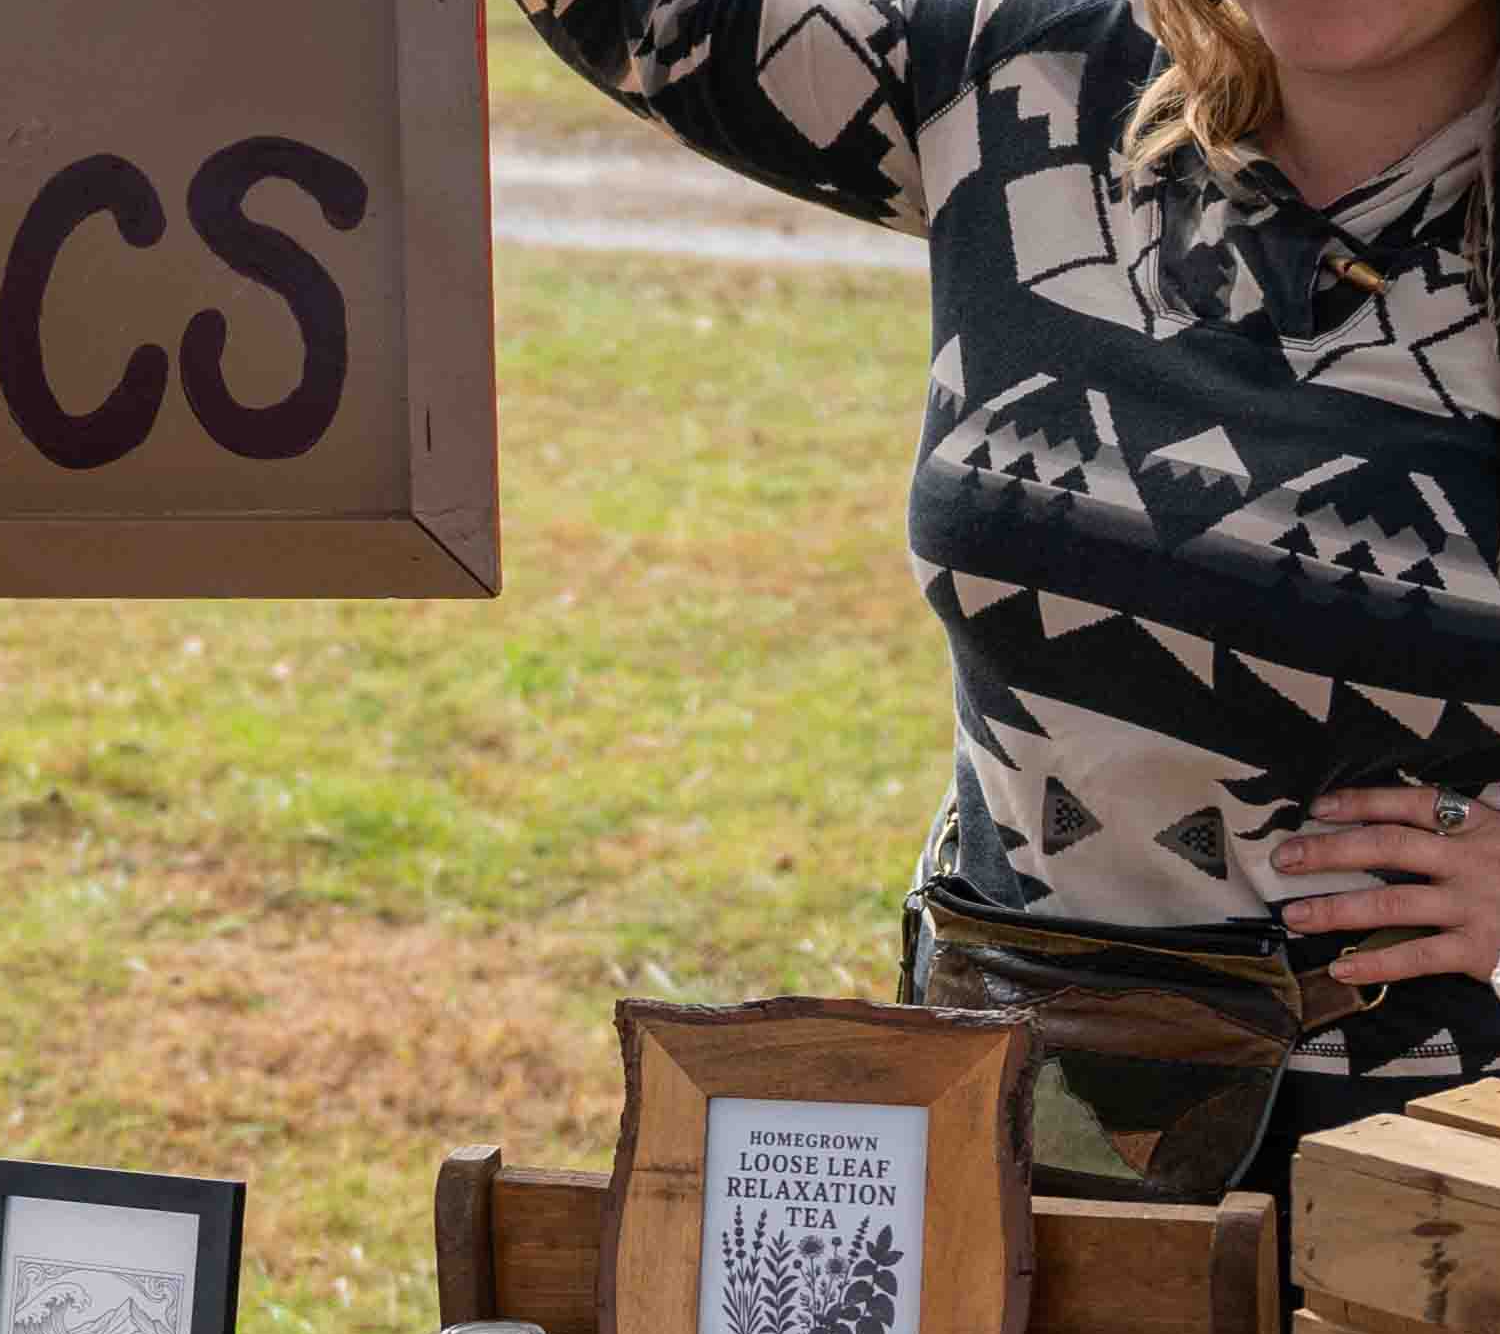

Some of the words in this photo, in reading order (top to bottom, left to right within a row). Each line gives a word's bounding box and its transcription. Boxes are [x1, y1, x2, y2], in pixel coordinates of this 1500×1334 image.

[750, 1130, 878, 1151] HOMEGROWN
[740, 1152, 819, 1175] LOOSE
[827, 1155, 890, 1180] LEAF
[727, 1177, 897, 1206] RELAXATION
[786, 1206, 838, 1230] TEA
